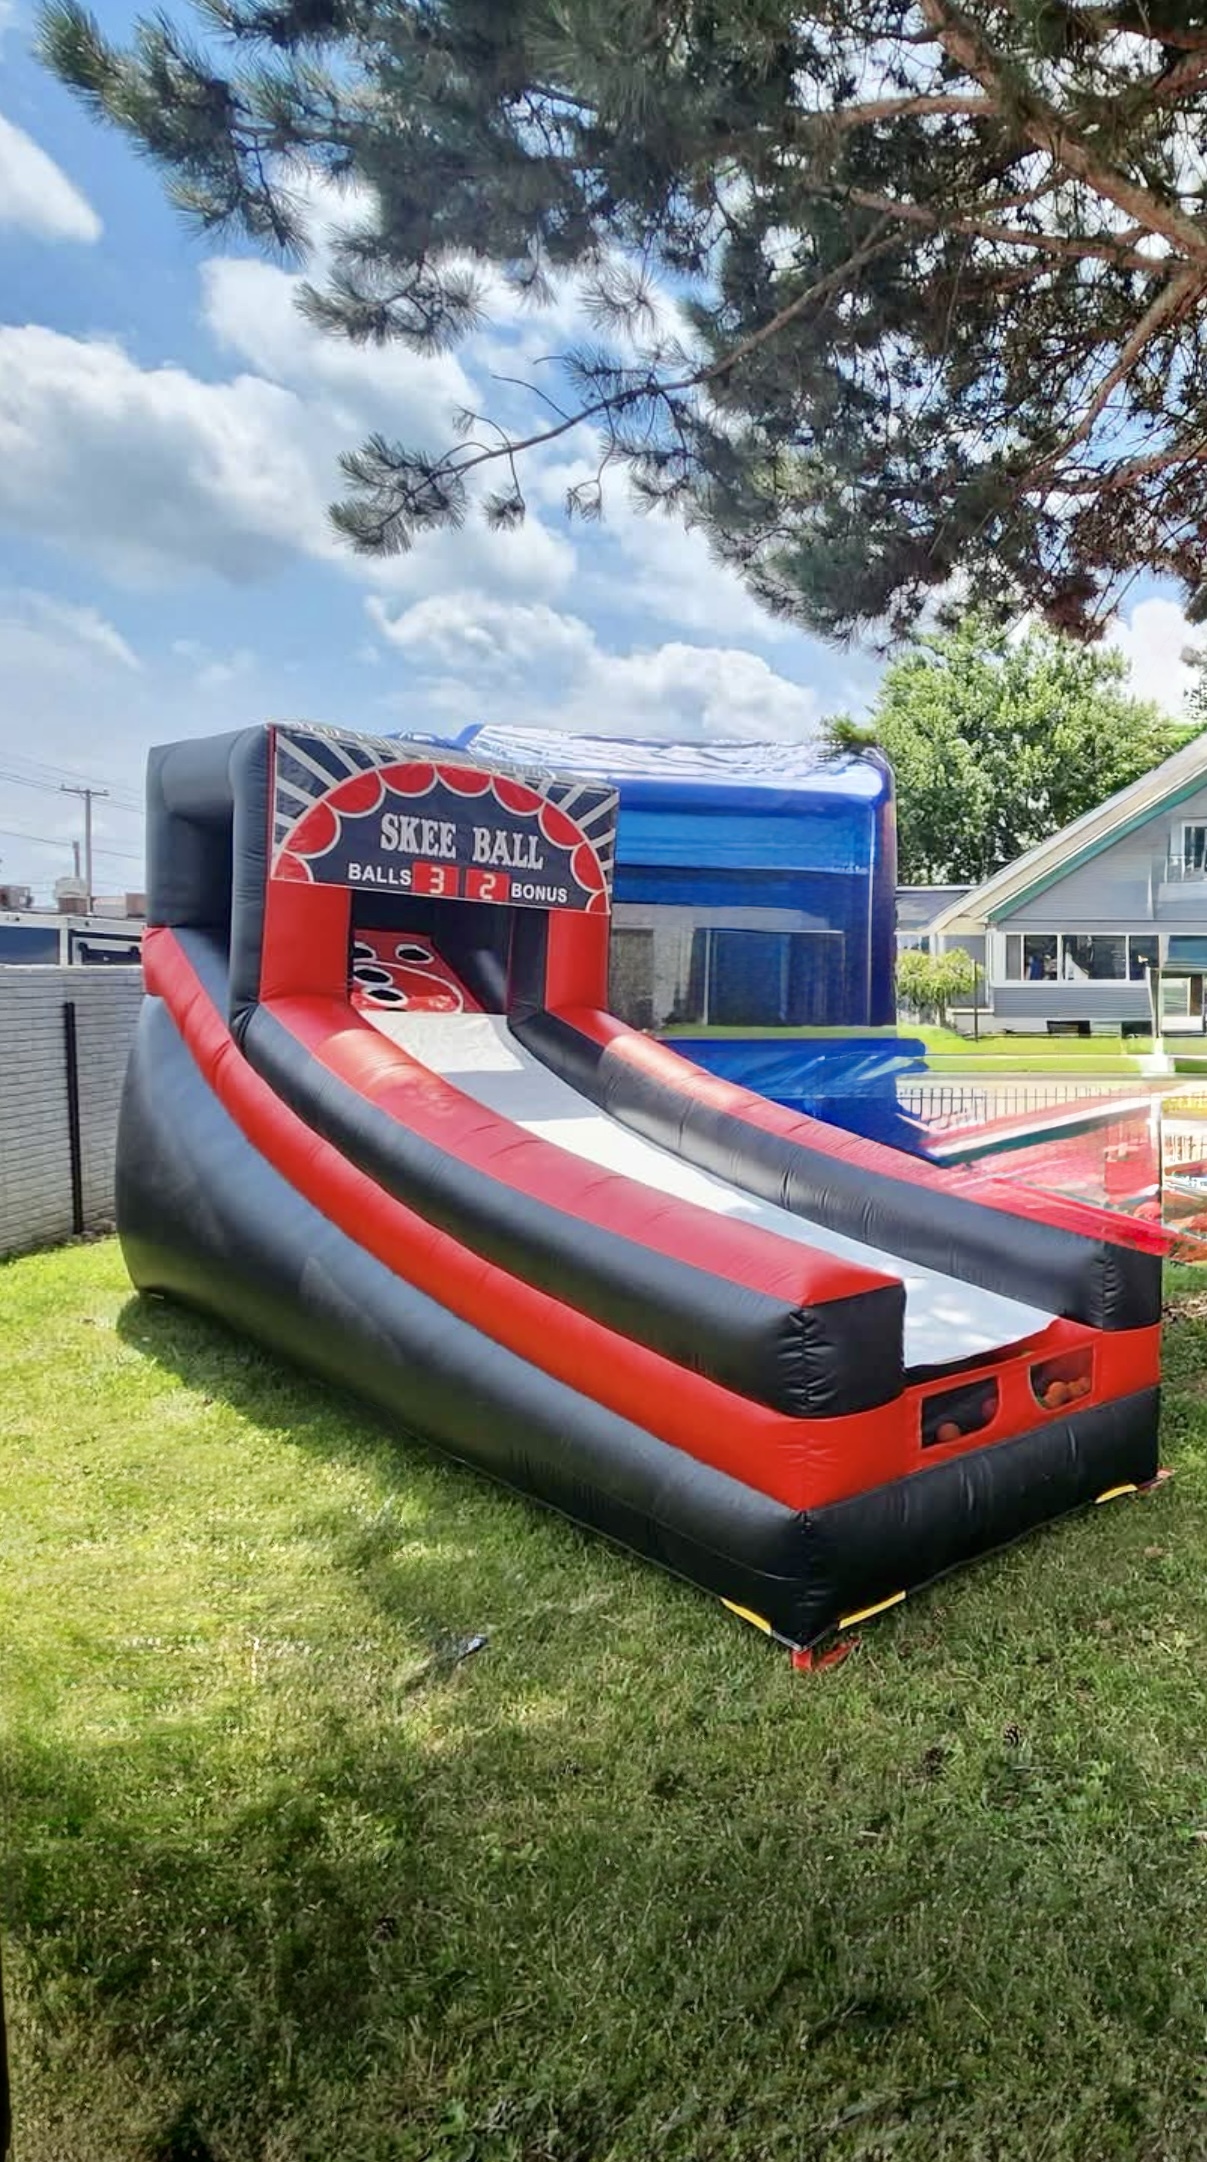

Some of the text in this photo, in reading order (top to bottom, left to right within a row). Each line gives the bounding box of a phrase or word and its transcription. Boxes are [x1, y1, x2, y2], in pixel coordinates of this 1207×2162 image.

[380, 813, 544, 869] SKEE BALL
[348, 863, 568, 903] BALLS 3 2 BONUS
